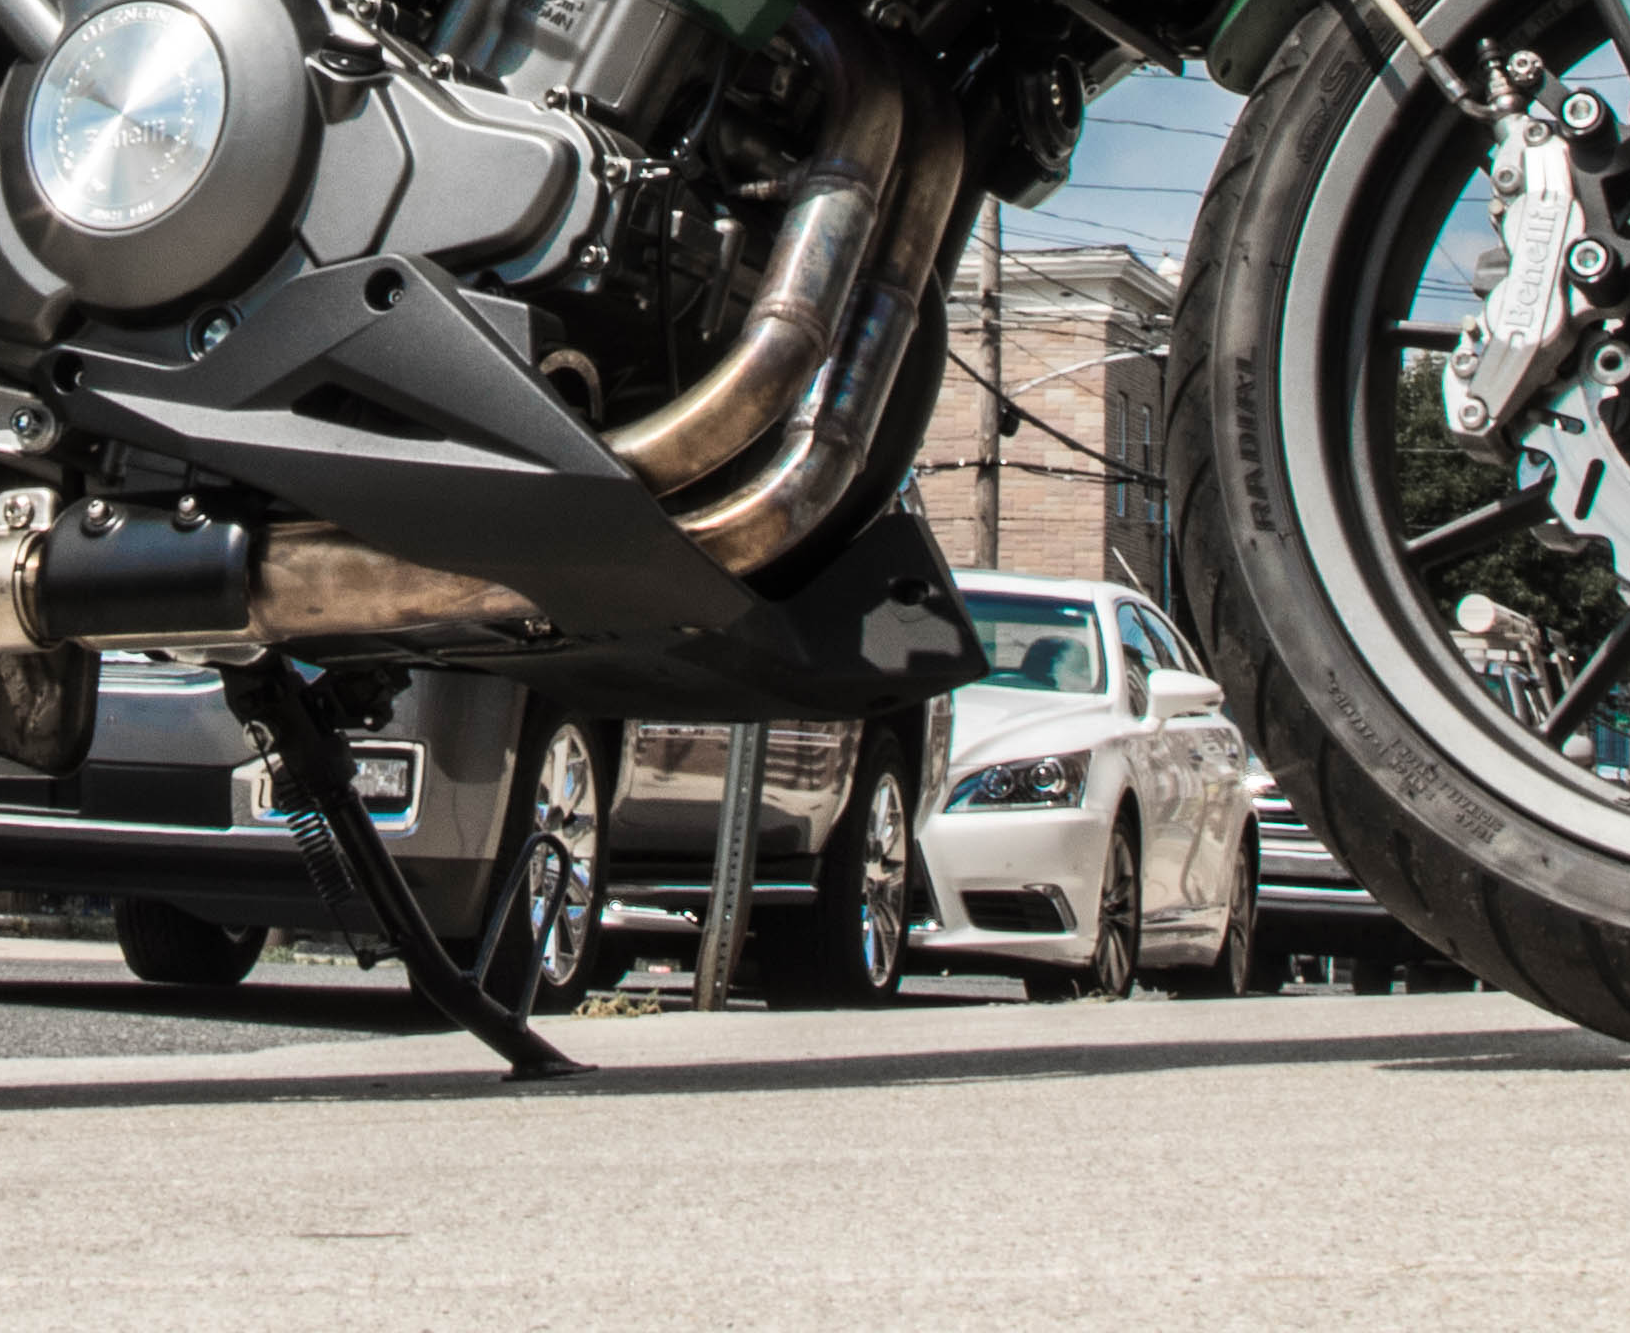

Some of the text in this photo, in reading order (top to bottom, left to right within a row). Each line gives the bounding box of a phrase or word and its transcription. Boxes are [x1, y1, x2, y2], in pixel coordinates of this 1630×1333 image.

[83, 117, 167, 149] Bnelli
[1510, 197, 1559, 330] Benelli
[1230, 351, 1276, 533] RADIAL
